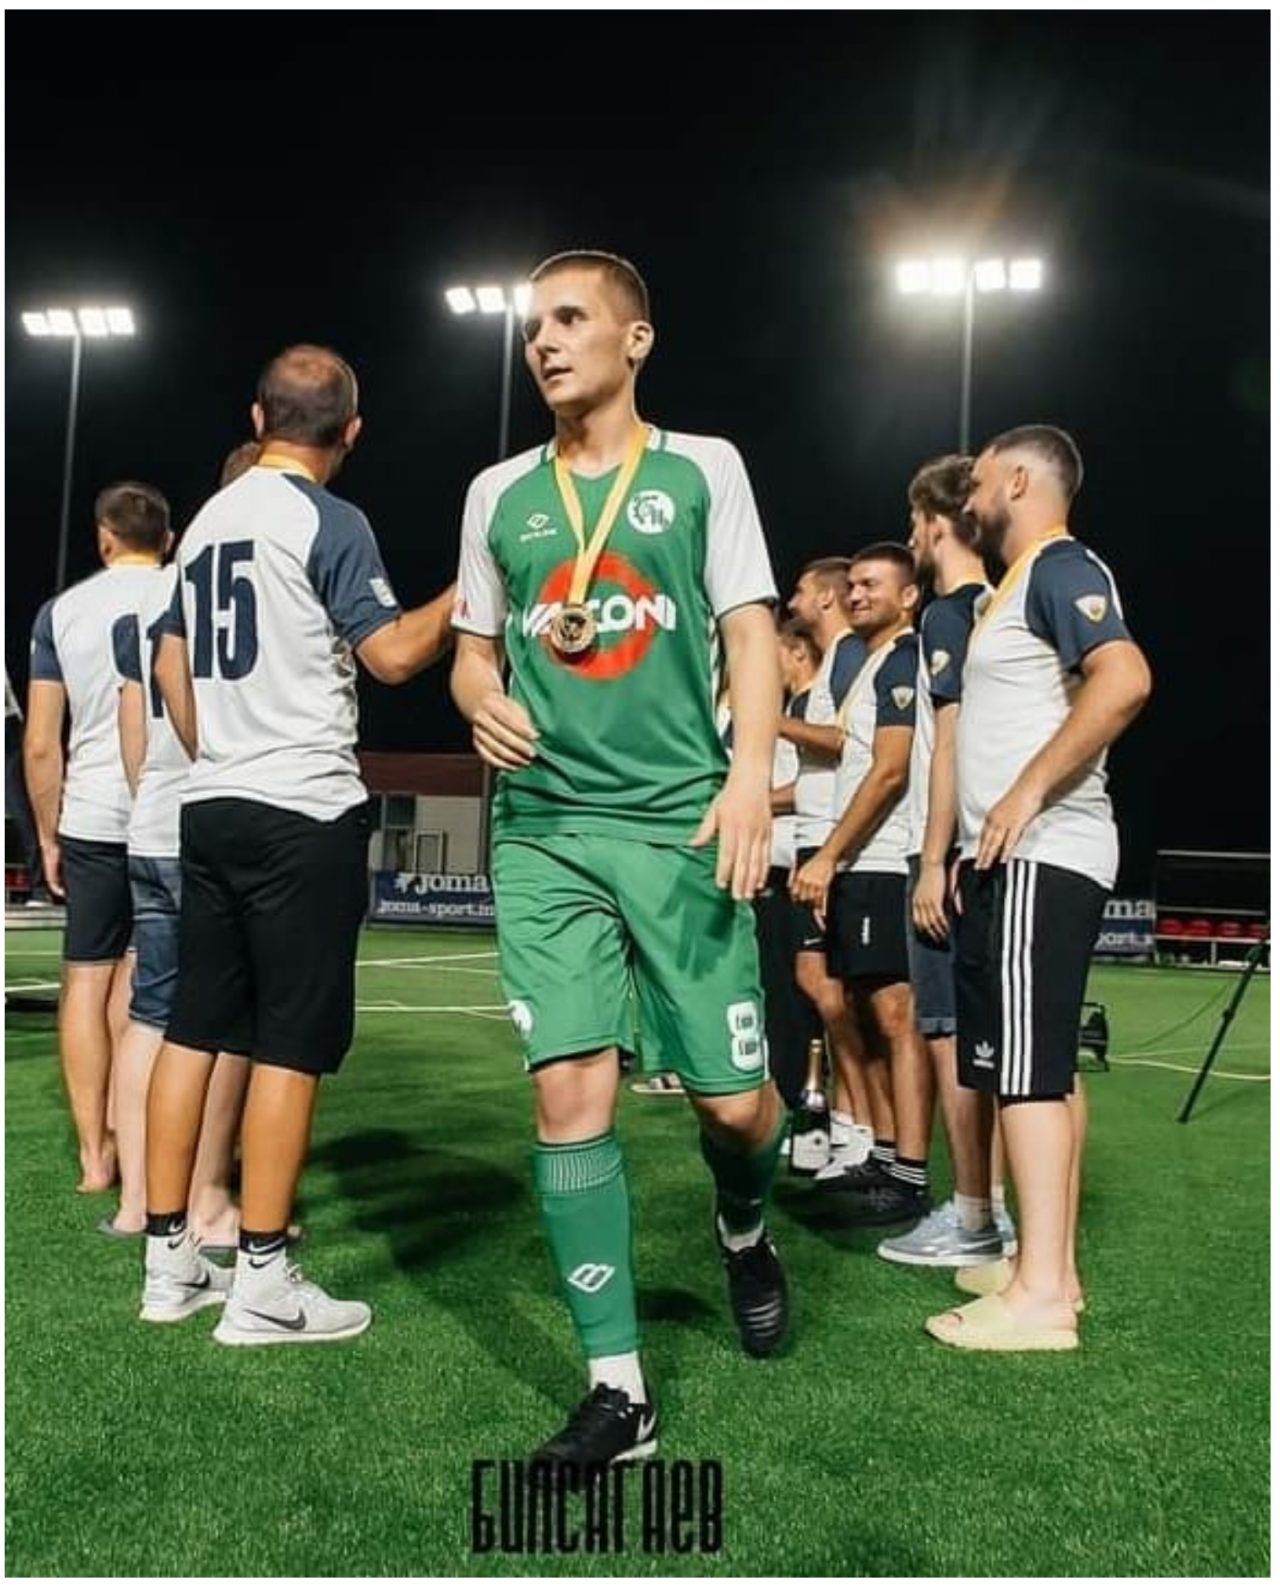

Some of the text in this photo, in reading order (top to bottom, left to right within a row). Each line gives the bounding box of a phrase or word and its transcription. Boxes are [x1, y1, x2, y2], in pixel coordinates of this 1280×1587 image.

[185, 540, 258, 680] 15
[1103, 899, 1155, 919] ma
[727, 1001, 763, 1071] 8
